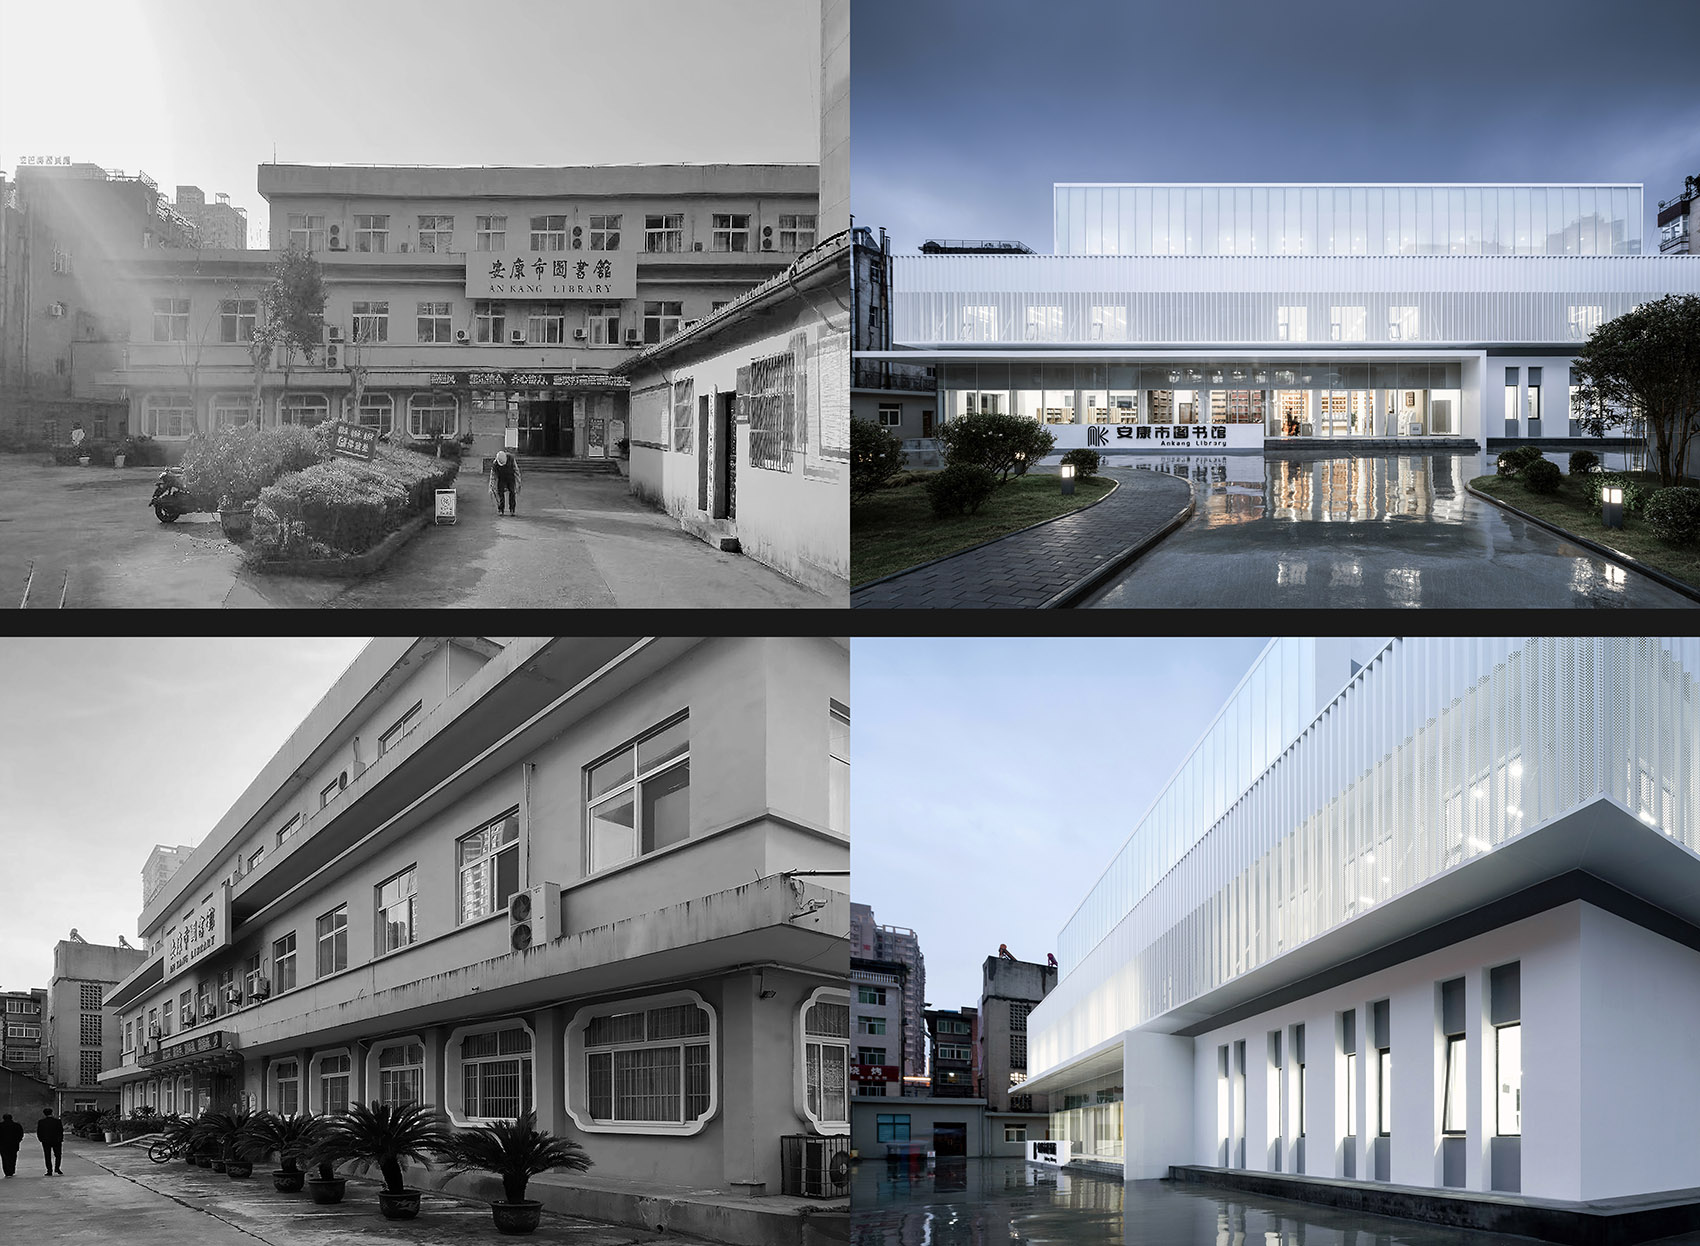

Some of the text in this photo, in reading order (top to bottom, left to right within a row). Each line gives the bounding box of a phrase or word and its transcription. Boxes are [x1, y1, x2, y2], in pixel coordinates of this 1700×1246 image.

[488, 257, 613, 281] 安康市圖書館
[553, 284, 612, 293] LIBRARY
[1116, 425, 1227, 440] 安康市图书馆
